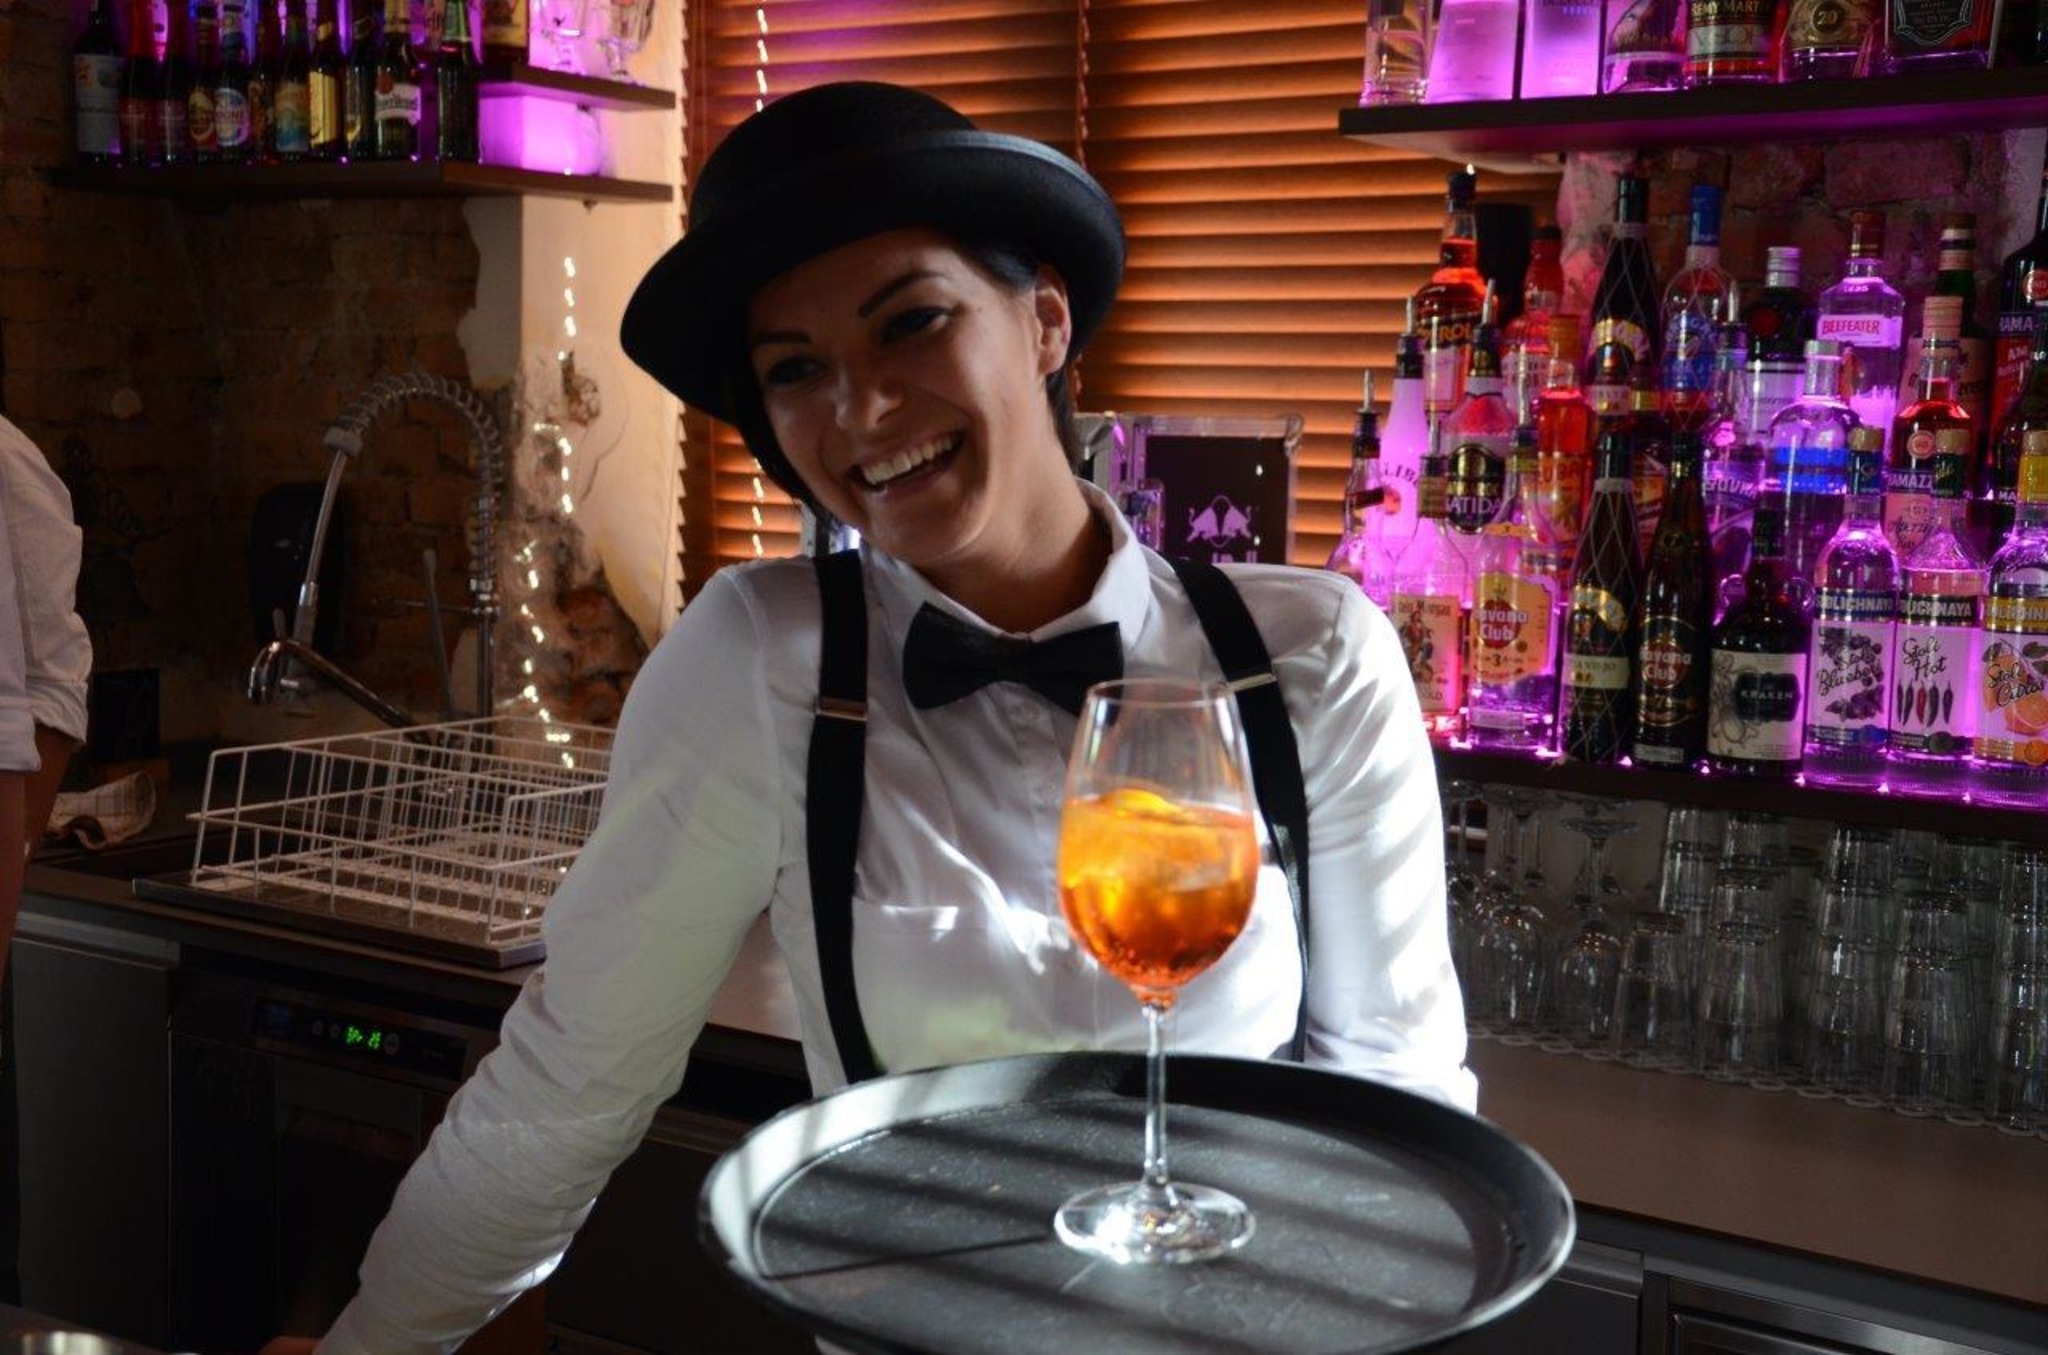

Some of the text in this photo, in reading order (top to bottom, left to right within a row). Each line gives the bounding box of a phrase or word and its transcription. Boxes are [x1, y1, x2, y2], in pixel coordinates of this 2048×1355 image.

[1822, 319, 1880, 335] BEEFEATER
[1903, 636, 1940, 665] Stoli
[1645, 664, 1678, 681] Club
[1911, 655, 1947, 681] Hot
[1988, 662, 2022, 689] Stoli
[1740, 690, 1793, 700] KRAKEN
